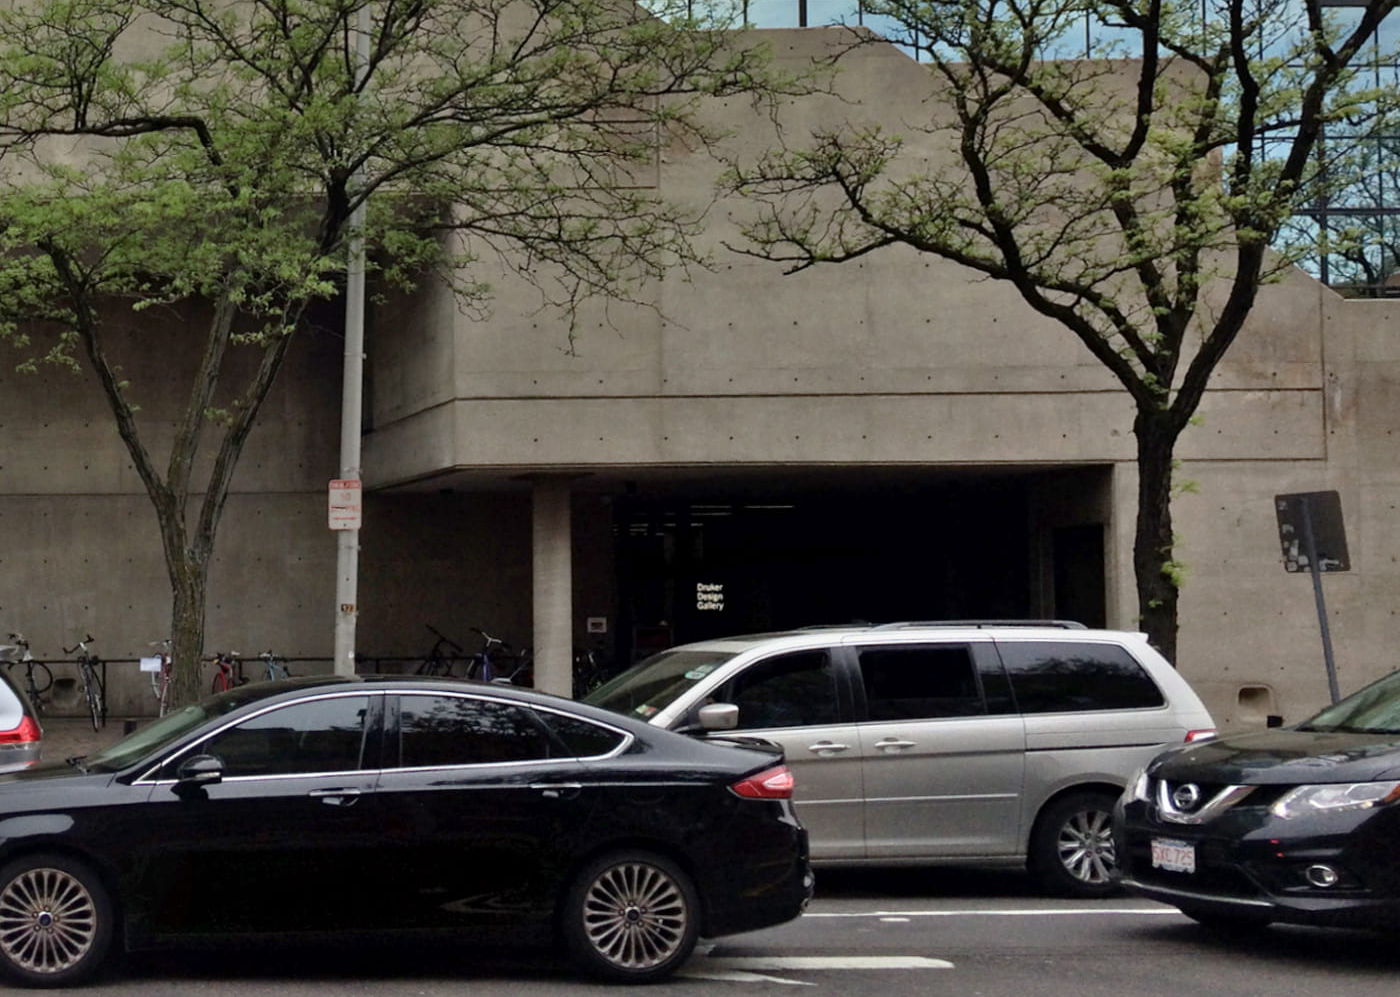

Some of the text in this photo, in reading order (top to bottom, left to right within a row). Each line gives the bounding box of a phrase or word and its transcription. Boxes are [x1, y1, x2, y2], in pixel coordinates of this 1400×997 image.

[697, 583, 723, 592] Druker
[697, 592, 724, 602] Design
[696, 602, 724, 612] Gallery
